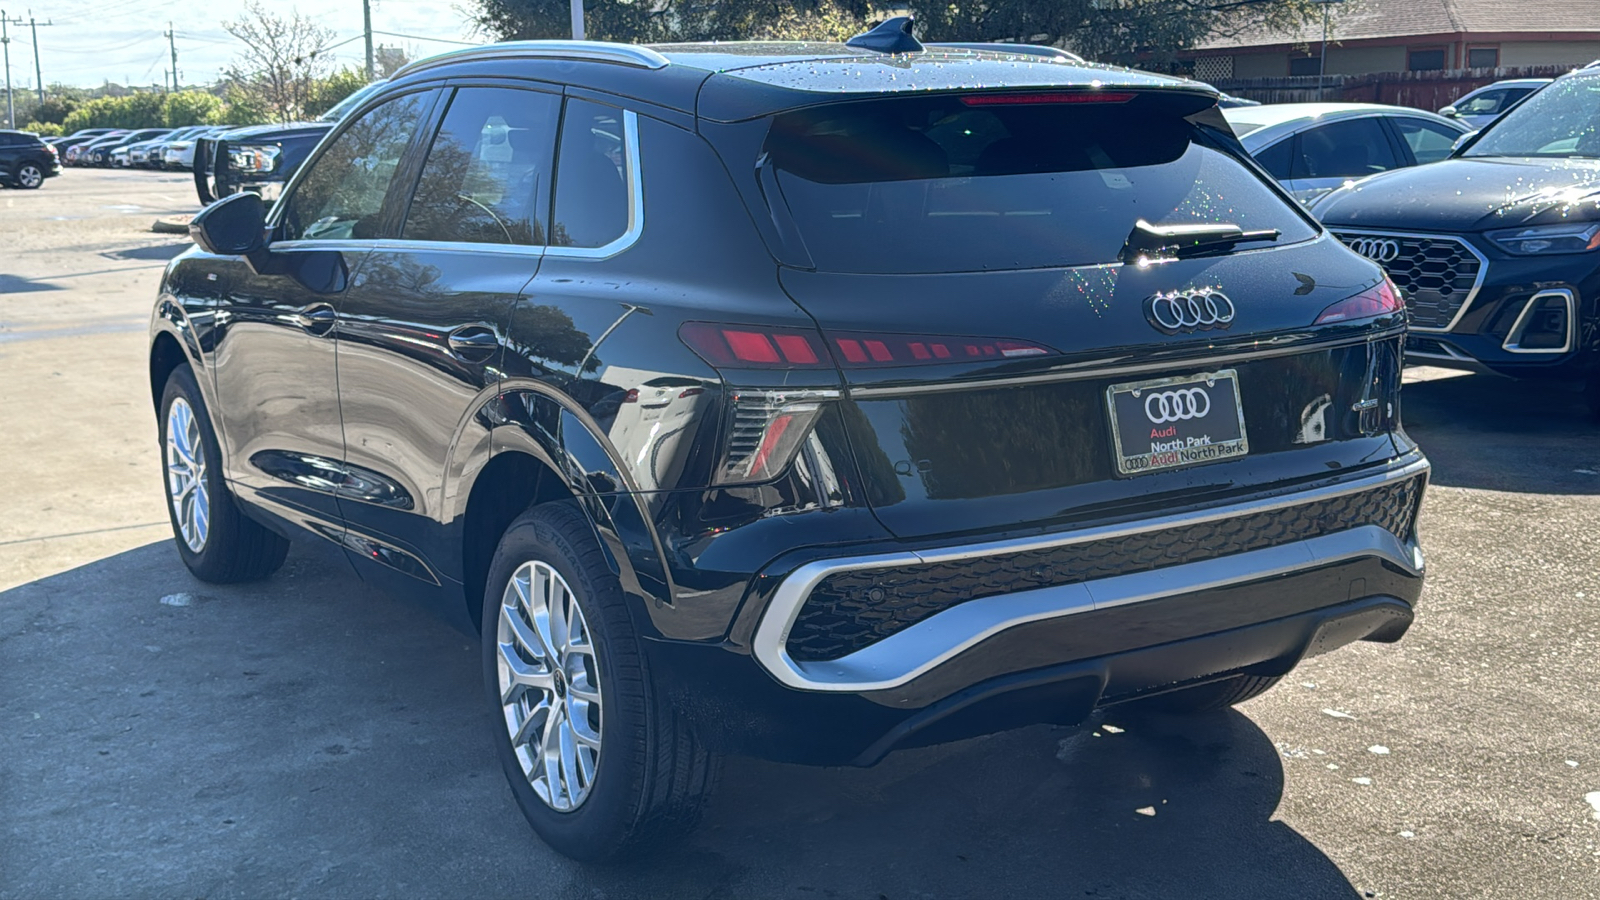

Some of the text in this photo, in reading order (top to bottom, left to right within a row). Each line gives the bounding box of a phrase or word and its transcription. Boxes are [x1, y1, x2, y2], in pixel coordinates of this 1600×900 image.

[1150, 426, 1177, 438] Audi
[1151, 434, 1211, 453] North Park
[1151, 442, 1244, 466] Audi North Park
[550, 533, 593, 602] TURANZA
